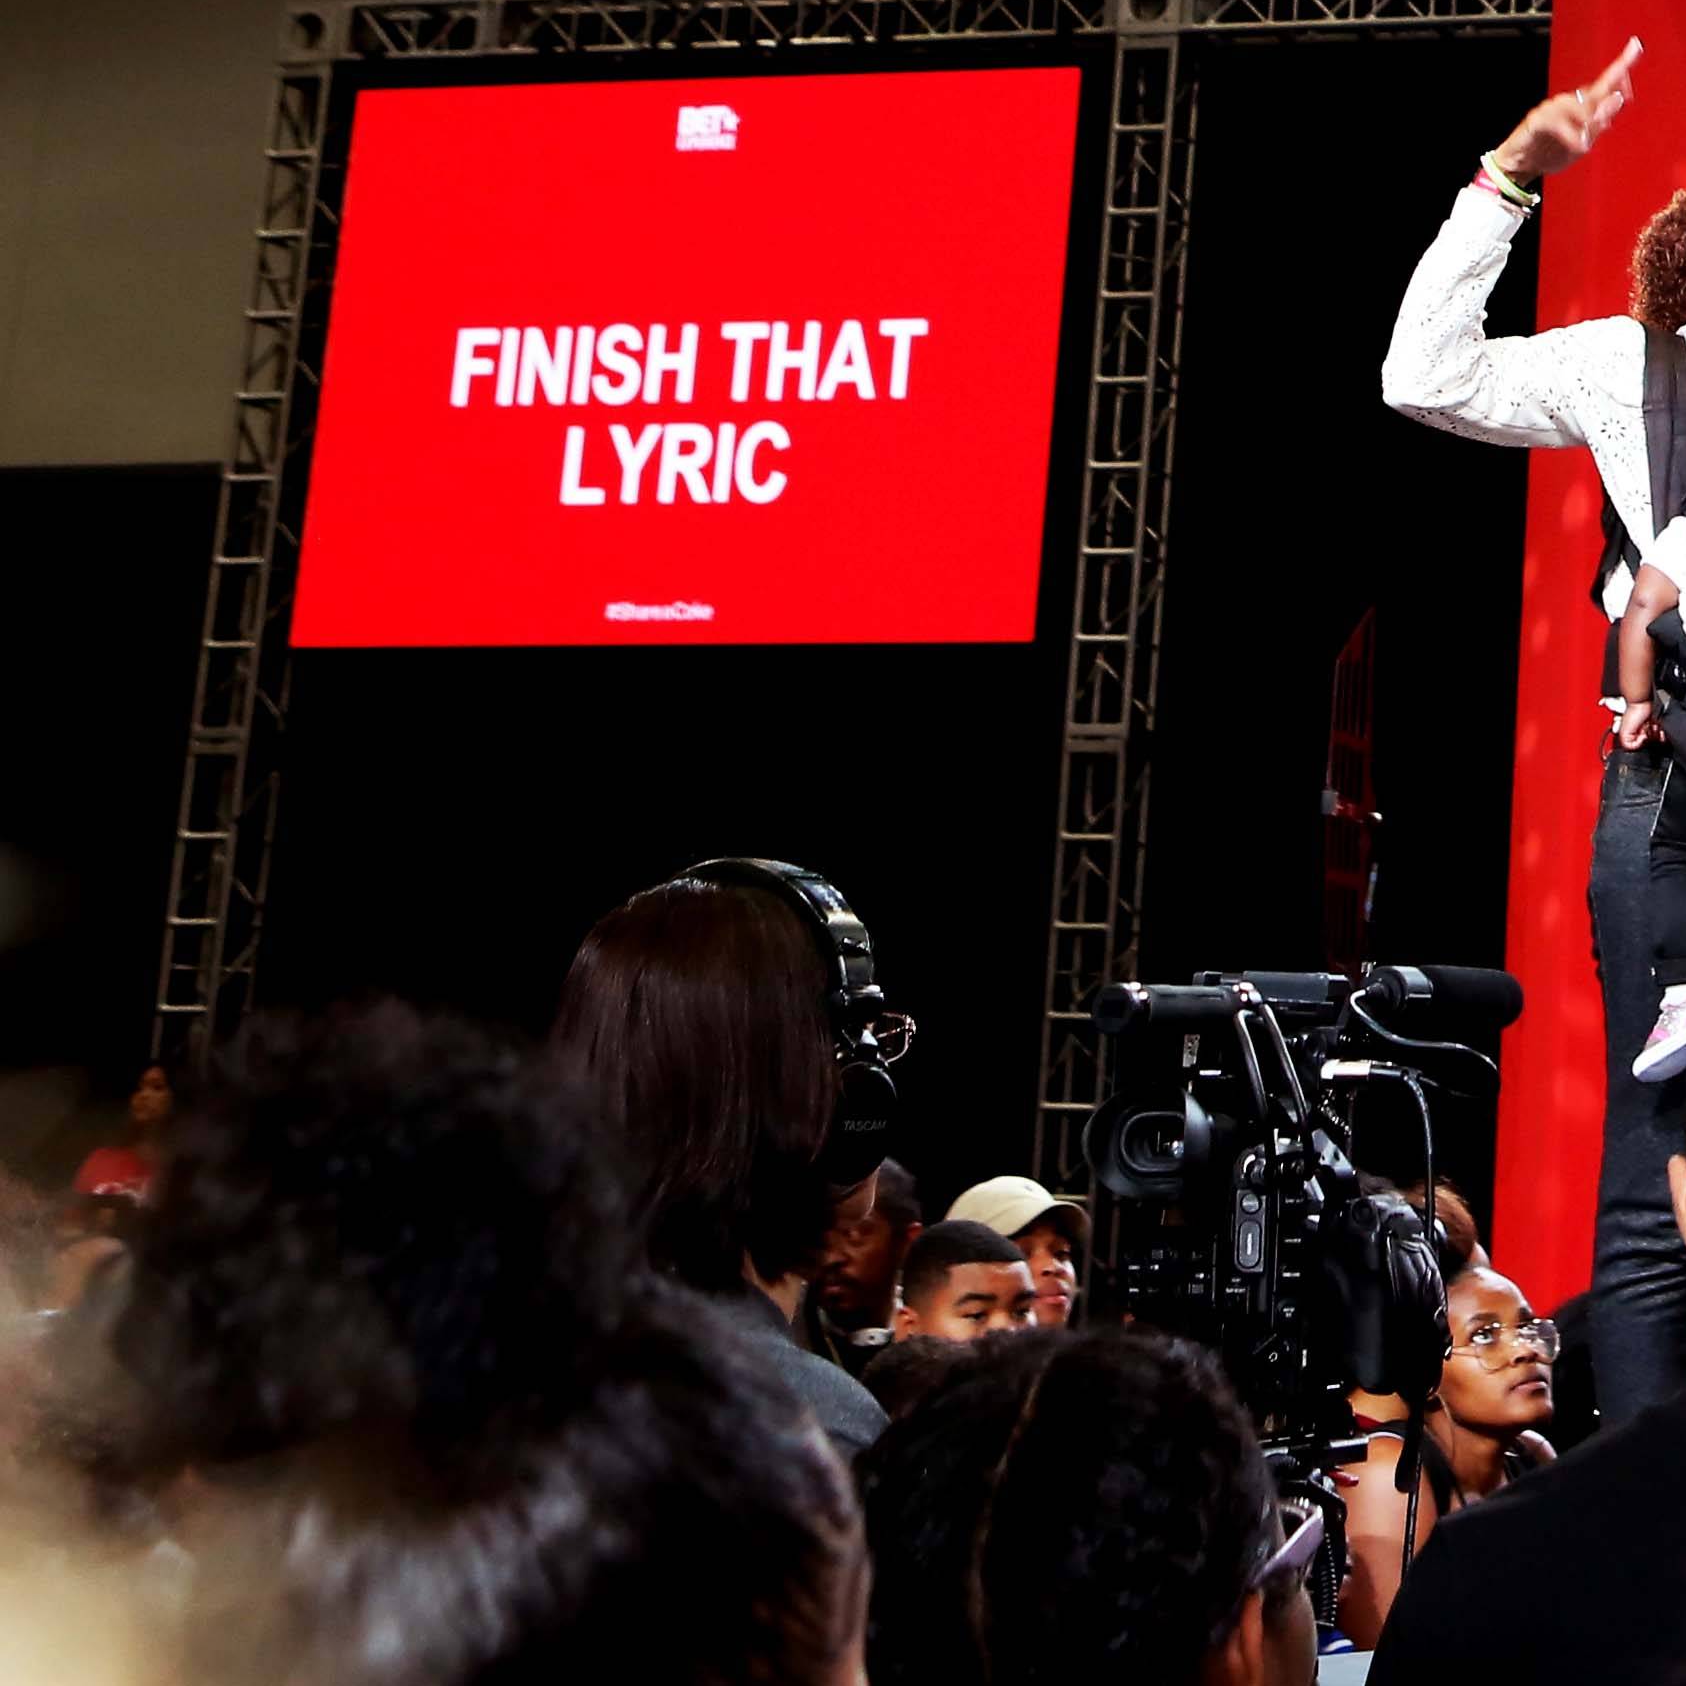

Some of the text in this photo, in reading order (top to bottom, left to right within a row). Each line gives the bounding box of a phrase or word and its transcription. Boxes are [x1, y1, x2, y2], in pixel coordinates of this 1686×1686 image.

[449, 317, 930, 408] FINISH THAT
[558, 420, 791, 507] LYRIC
